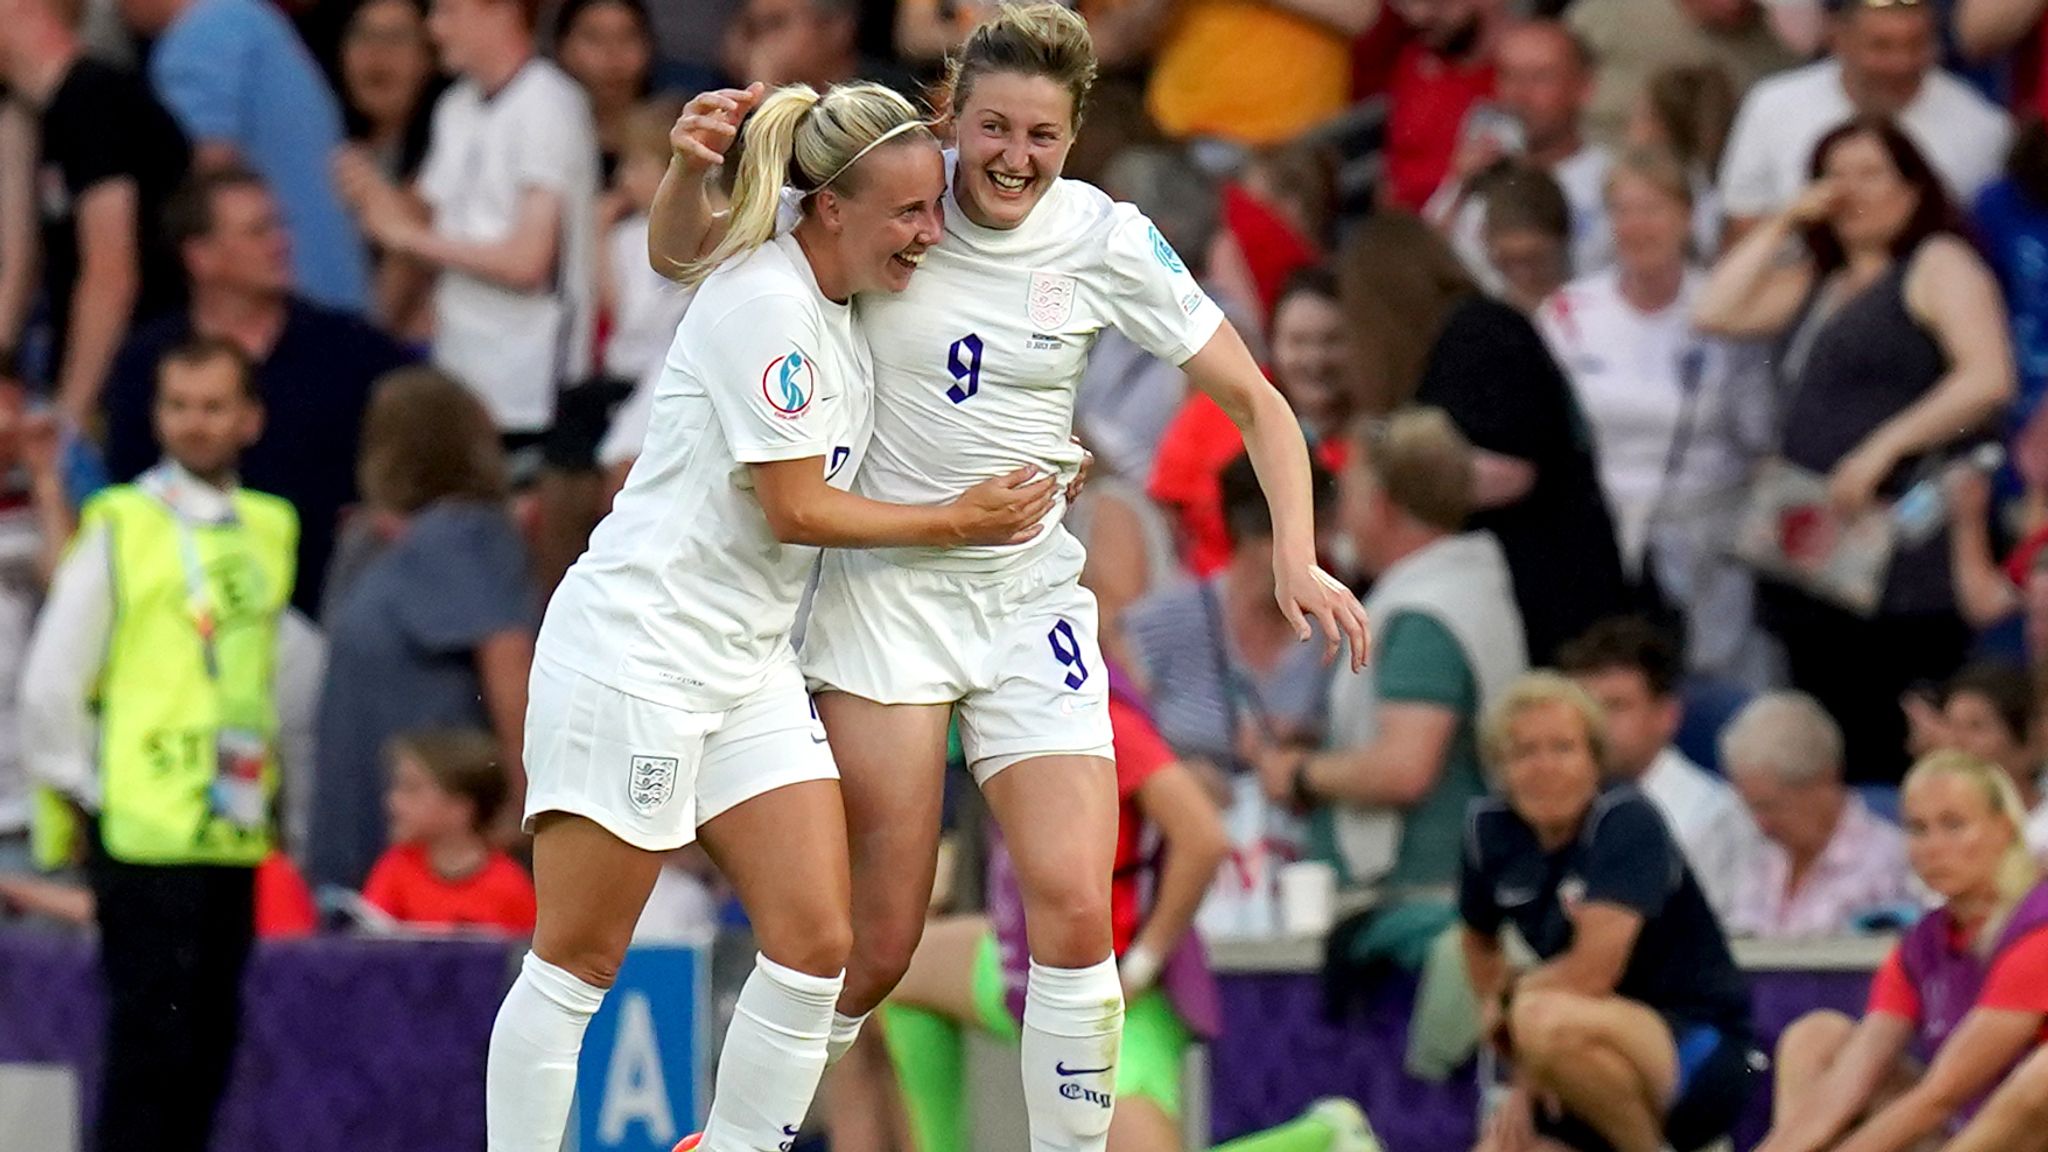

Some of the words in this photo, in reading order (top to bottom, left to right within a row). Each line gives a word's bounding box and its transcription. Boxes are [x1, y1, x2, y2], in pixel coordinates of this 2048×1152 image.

[946, 333, 984, 404] 9
[1048, 619, 1088, 690] 9
[597, 989, 676, 1144] A
